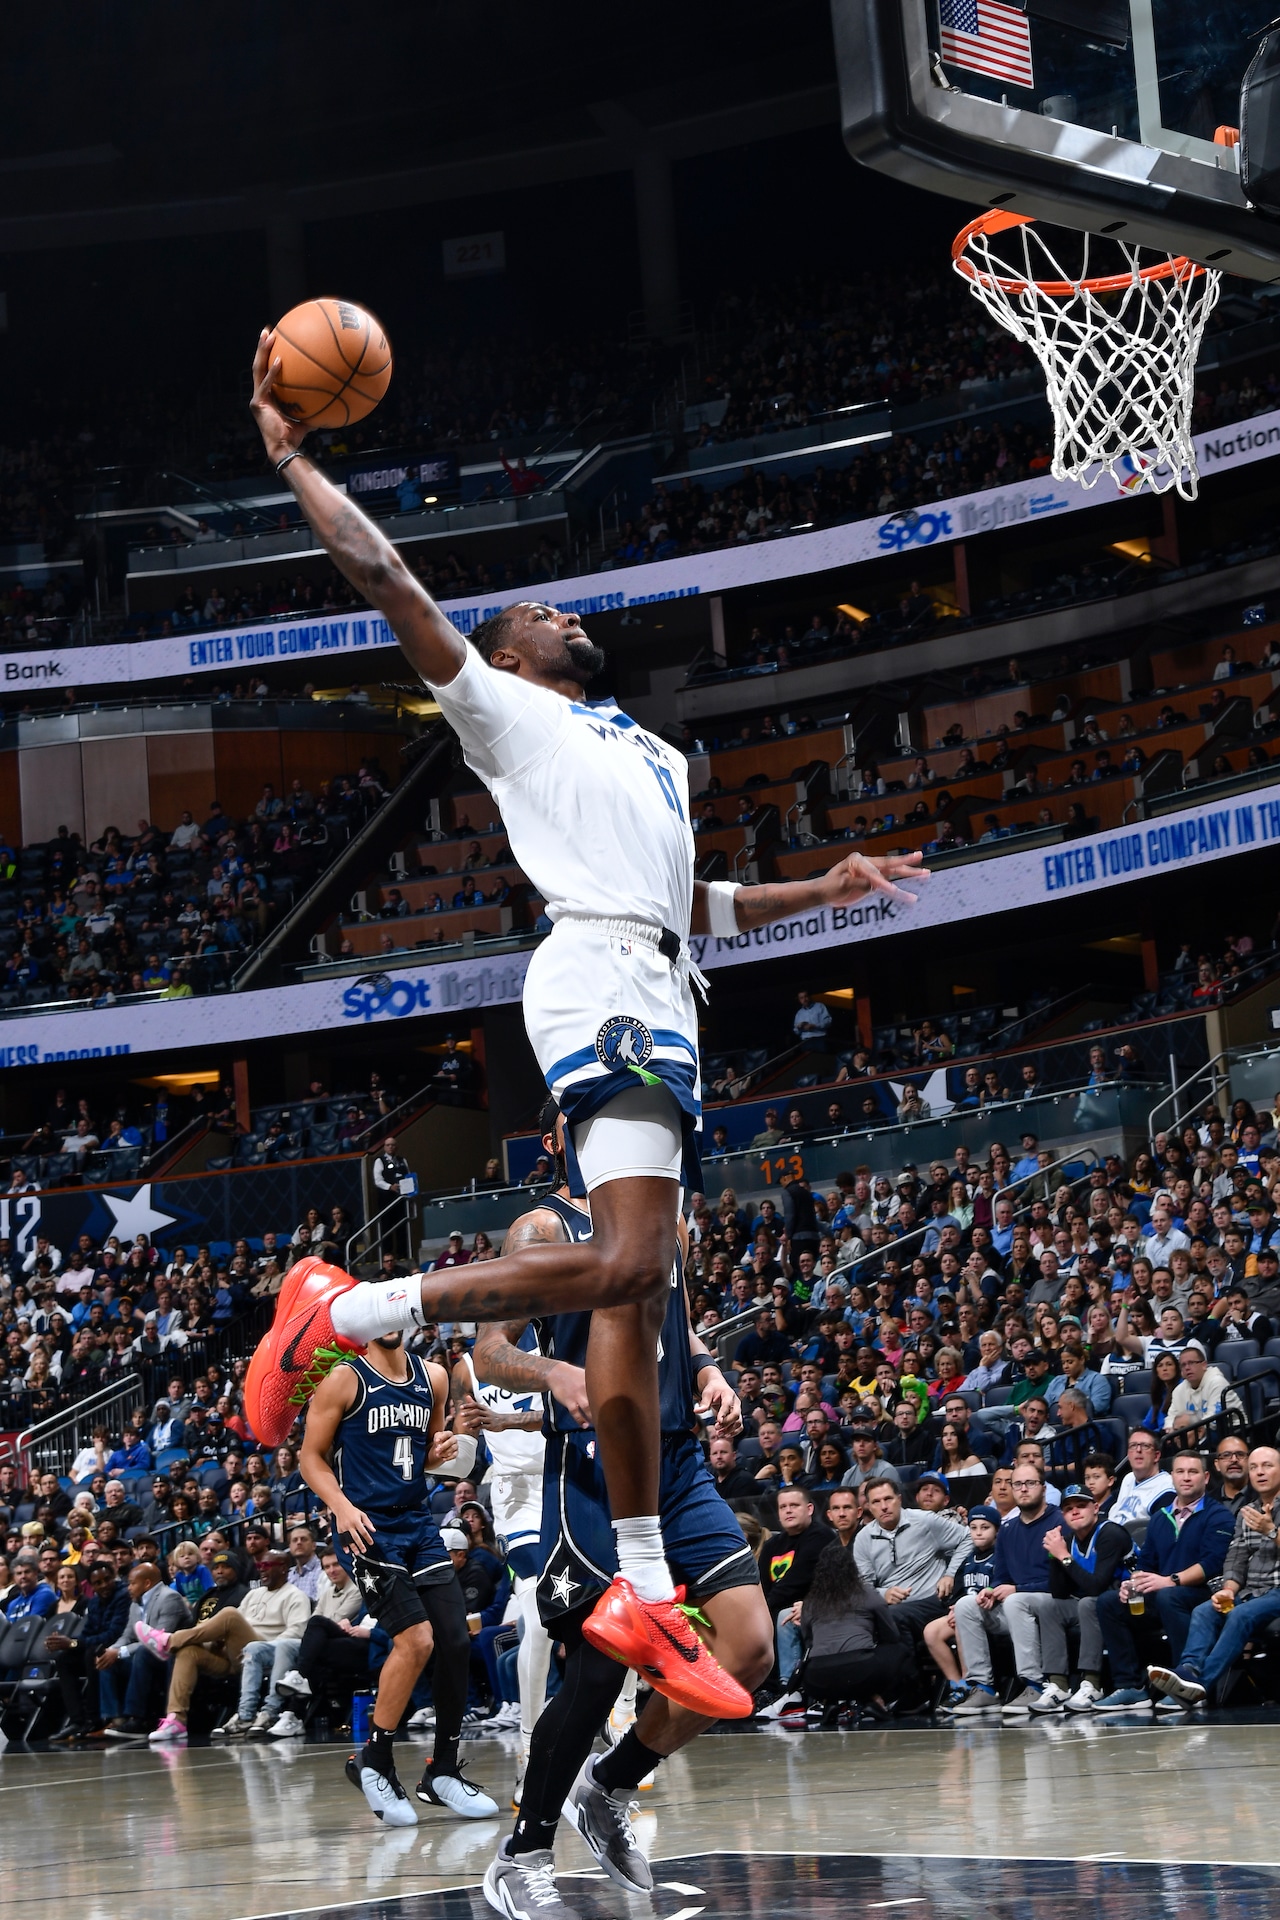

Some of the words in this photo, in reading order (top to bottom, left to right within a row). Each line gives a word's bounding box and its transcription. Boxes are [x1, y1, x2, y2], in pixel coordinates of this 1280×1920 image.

[456, 242, 495, 263] 221
[959, 493, 1029, 533] light
[190, 636, 233, 666] ENTER
[235, 631, 275, 660] YOUR
[278, 621, 349, 655] COMPANY
[352, 619, 367, 646] IN
[5, 660, 63, 680] Bank
[1044, 846, 1096, 891] ENTER
[1097, 833, 1144, 878] YOUR
[1146, 809, 1231, 866] COMPANY
[1235, 804, 1255, 845] IN
[832, 898, 897, 930] Bank
[438, 967, 521, 1008] light
[393, 1436, 414, 1481] 4
